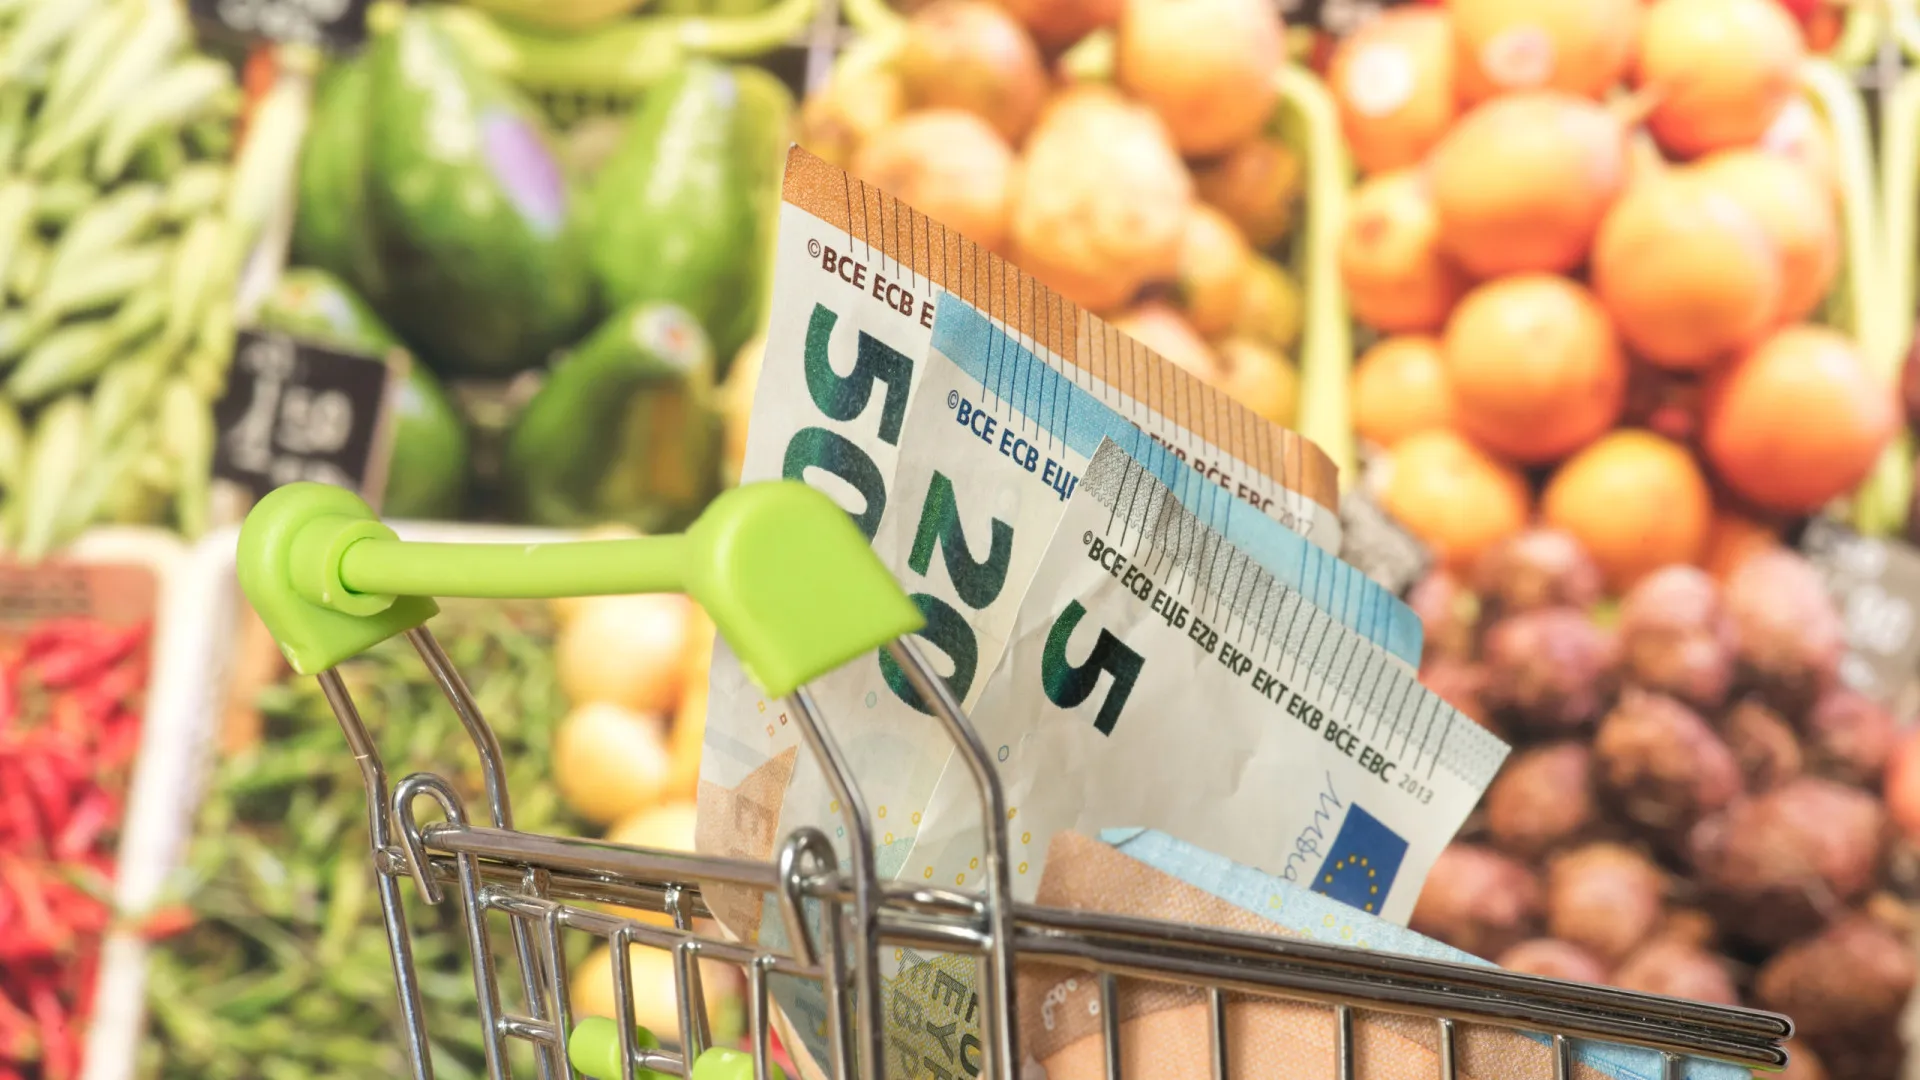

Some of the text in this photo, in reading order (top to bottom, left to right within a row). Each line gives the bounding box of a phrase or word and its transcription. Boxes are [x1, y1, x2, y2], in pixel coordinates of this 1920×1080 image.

[872, 273, 915, 318] ECB
[782, 301, 914, 543] 50
[999, 428, 1040, 474] ECB
[879, 470, 1015, 718] 20
[1042, 598, 1146, 738] 5
[1120, 564, 1154, 602] ECB
[1187, 617, 1219, 654] EZB
[1217, 641, 1254, 677] EKP
[1251, 668, 1290, 705] EKT
[1286, 693, 1325, 732] EKB
[1357, 745, 1397, 784] EBC
[1397, 773, 1435, 806] 2013
